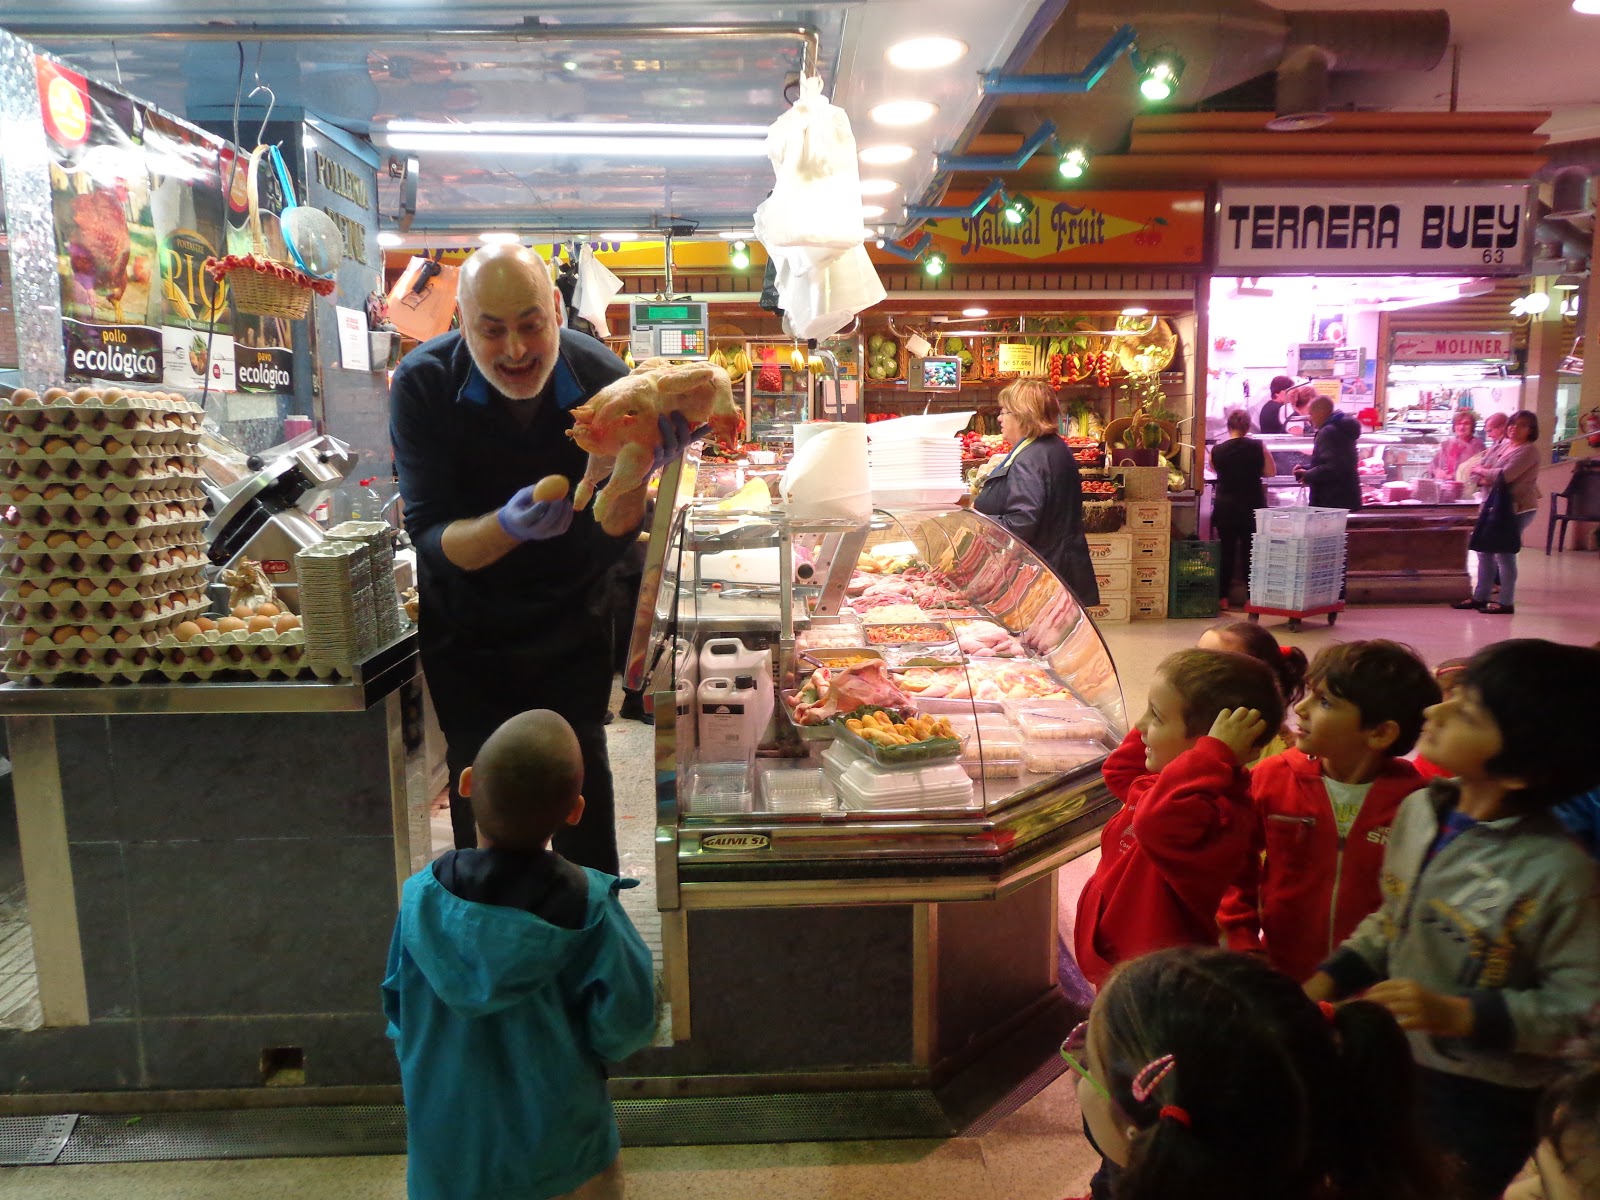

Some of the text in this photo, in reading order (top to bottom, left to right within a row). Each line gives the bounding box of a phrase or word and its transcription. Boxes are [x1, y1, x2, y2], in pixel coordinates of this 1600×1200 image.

[961, 200, 1105, 256] Natural Fruit
[1228, 204, 1520, 249] TERNERA BUEY
[1482, 248, 1504, 264] 63
[102, 329, 127, 344] pollo
[1435, 339, 1503, 354] MOLINER
[73, 345, 156, 378] ecológico
[257, 352, 272, 362] pavo
[239, 363, 290, 389] ecológico
[1089, 547, 1111, 557] BOLL
